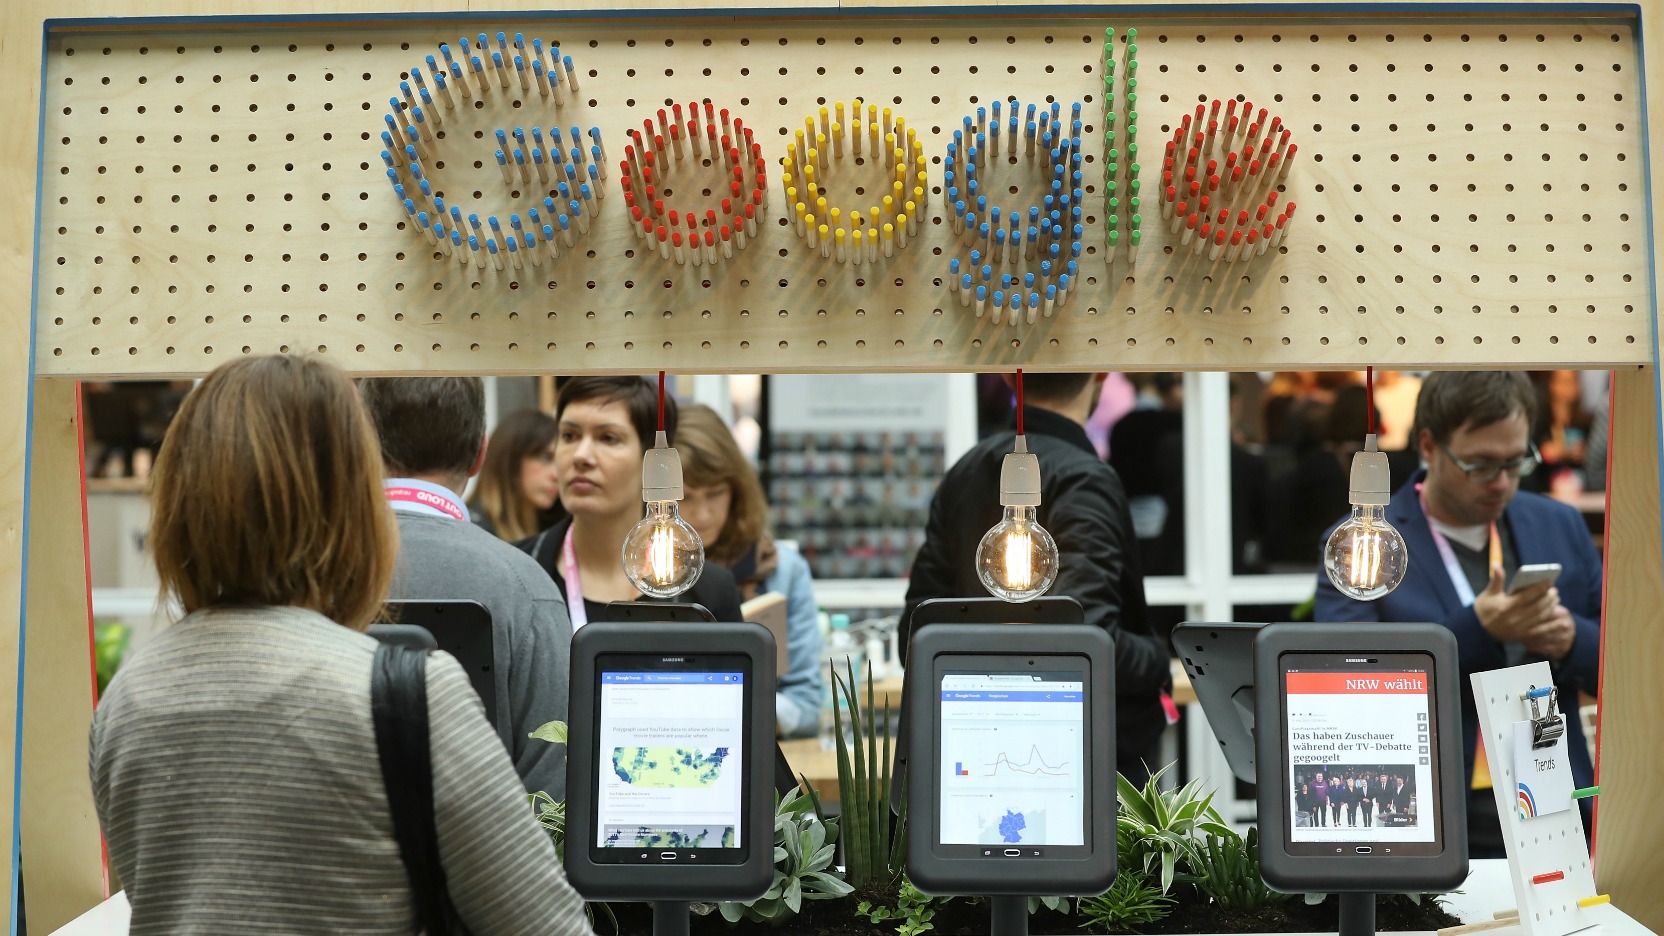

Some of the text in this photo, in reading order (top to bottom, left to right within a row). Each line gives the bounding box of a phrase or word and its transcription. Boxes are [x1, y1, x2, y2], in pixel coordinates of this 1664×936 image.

[381, 28, 1299, 326] Google
[416, 491, 446, 508] LOUD
[444, 500, 463, 518] OUT
[1345, 678, 1424, 690] NRW wählt
[1293, 731, 1395, 740] Das haben Zuschauer
[1293, 742, 1412, 751] während der TV-Debatte
[1293, 753, 1341, 764] gegoogelt
[1533, 756, 1556, 773] Trends
